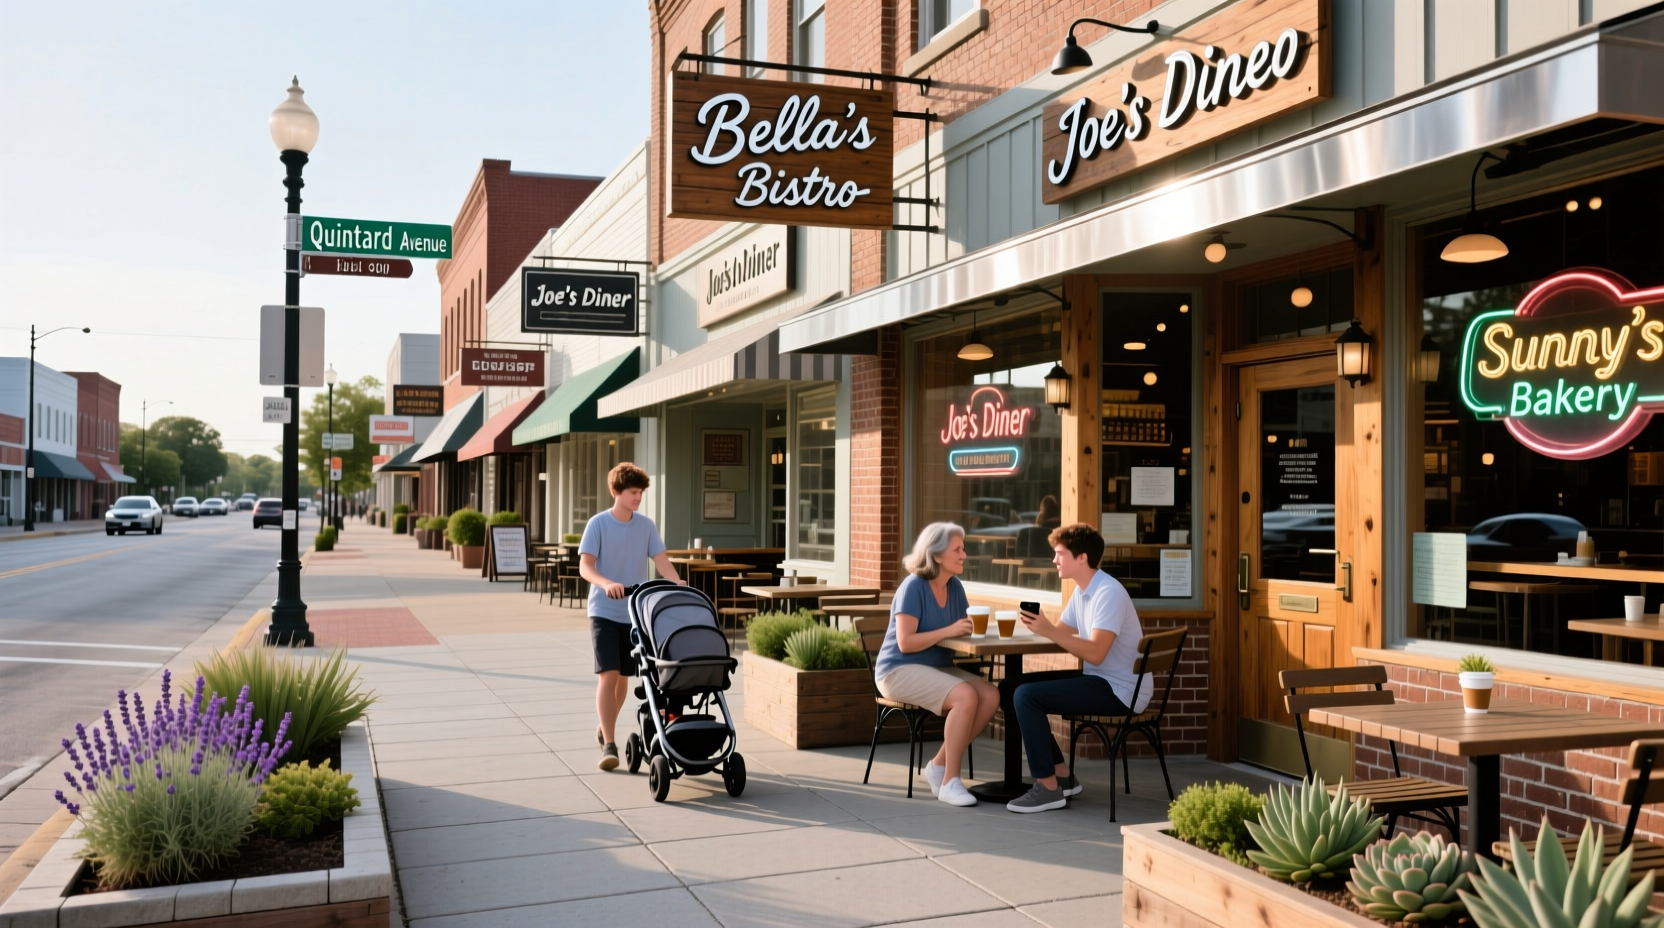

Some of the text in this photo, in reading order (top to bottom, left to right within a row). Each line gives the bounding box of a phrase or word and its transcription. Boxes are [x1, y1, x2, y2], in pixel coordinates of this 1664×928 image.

[690, 92, 877, 165] Bella's
[1047, 27, 1299, 185] Joe's Dineo
[735, 161, 871, 208] Bistro
[310, 220, 447, 253] Quintard Avenue
[531, 283, 632, 308] Joe's Diner
[1477, 305, 1664, 380] Sunny's
[1510, 378, 1637, 421] Bakery
[941, 401, 1031, 444] Joe's Diner
